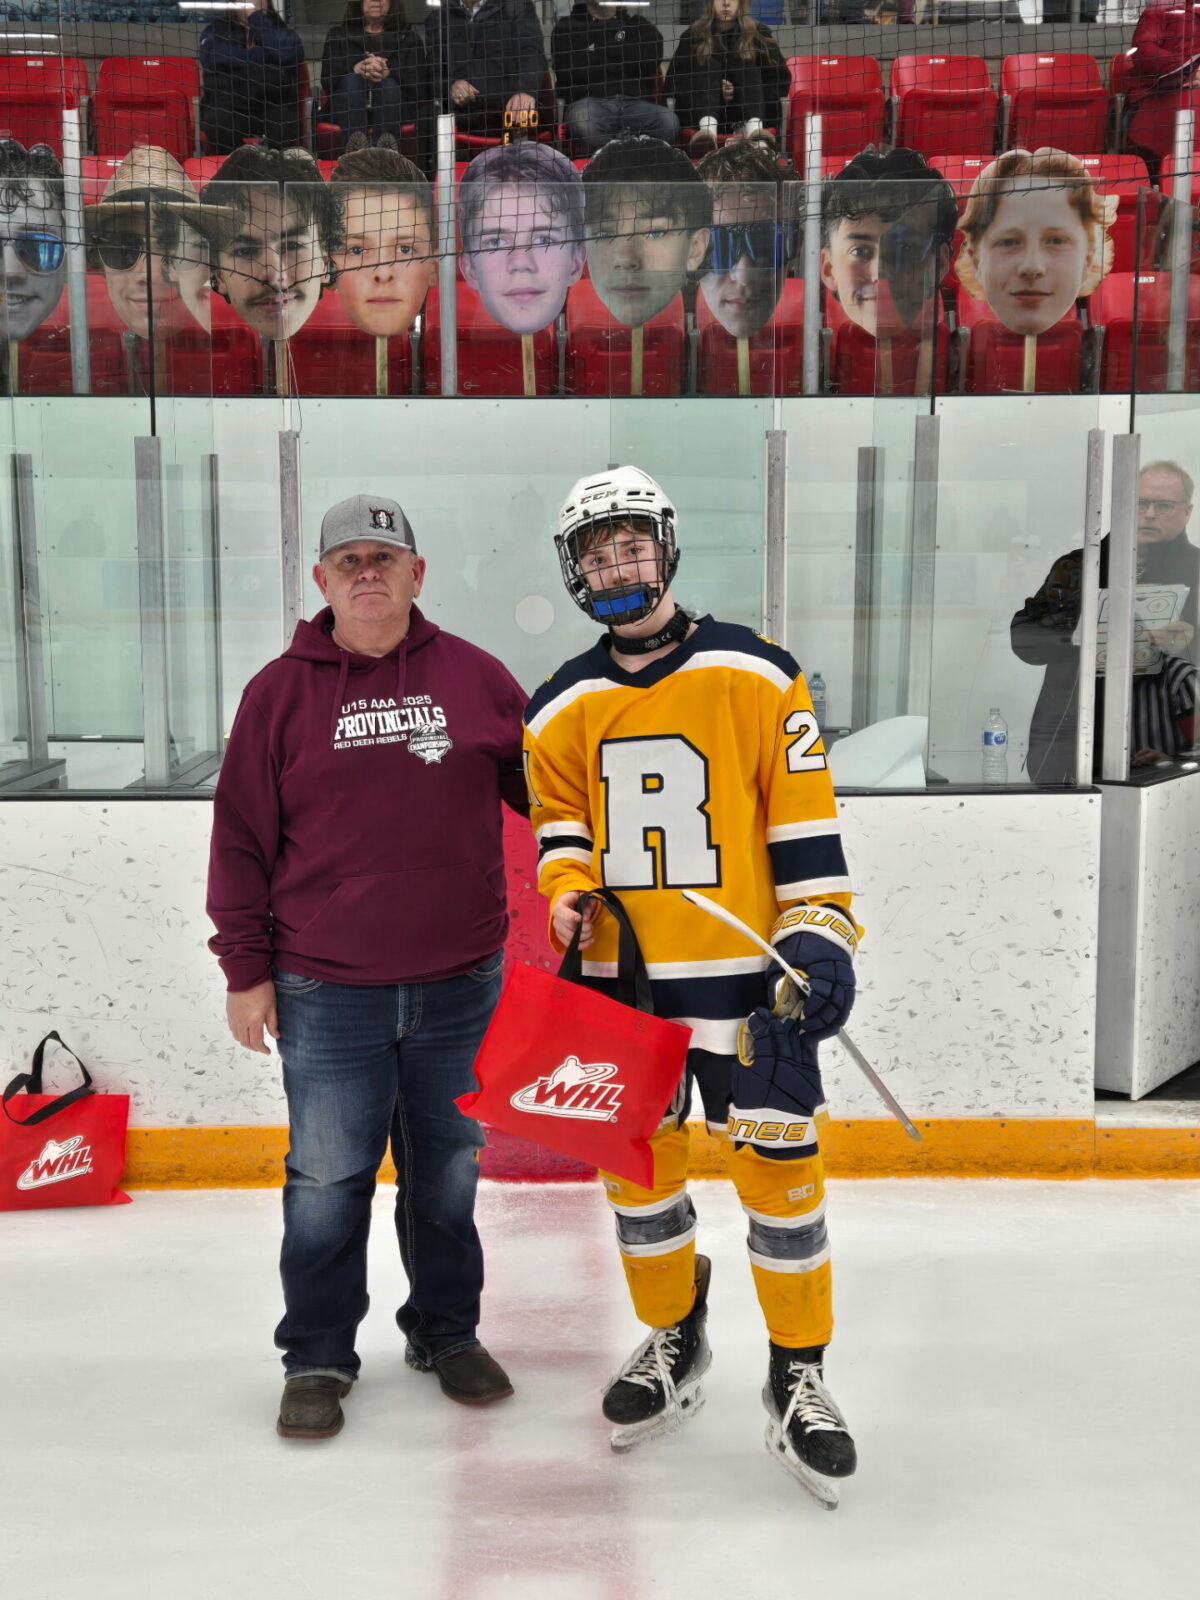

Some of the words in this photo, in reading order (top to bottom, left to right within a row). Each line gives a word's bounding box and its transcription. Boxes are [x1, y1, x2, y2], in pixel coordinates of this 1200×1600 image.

[580, 489, 619, 505] CCM
[341, 699, 368, 714] U15
[370, 698, 397, 709] AAA
[402, 695, 432, 706] 2025
[334, 706, 447, 741] PROVINCIALS
[334, 741, 351, 750] RED
[352, 738, 375, 747] DEER
[376, 733, 407, 744] REBELS
[599, 733, 723, 890] R
